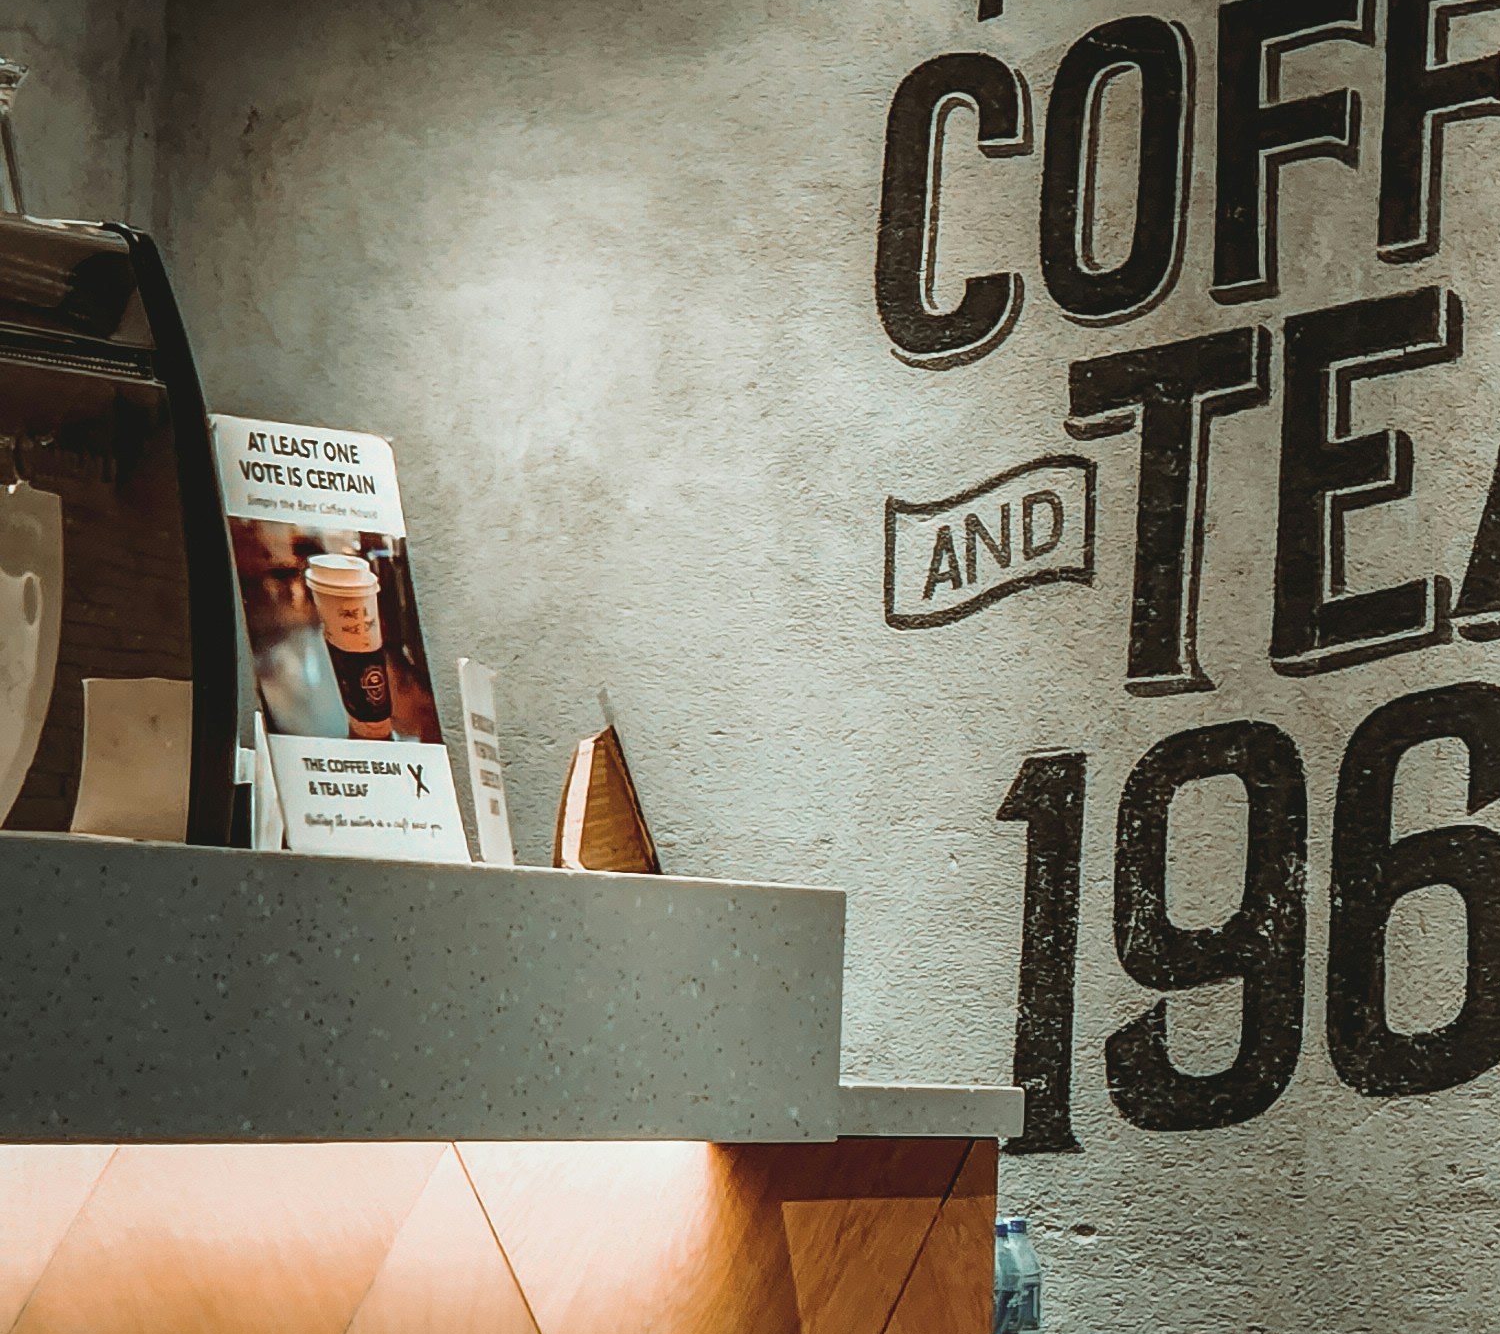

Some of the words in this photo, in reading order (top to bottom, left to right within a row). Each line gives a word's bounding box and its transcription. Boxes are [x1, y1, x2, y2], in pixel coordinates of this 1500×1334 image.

[247, 431, 267, 453] AT
[270, 434, 318, 459] LEAST
[323, 441, 360, 464] ONE
[238, 459, 285, 485] VOTE
[287, 466, 303, 487] IS
[306, 468, 376, 495] CERTAIN
[923, 488, 1064, 600] AND
[302, 757, 326, 772] THE
[327, 759, 370, 774] COFFEE
[371, 761, 402, 776] BEAN
[309, 781, 318, 796] &
[318, 781, 342, 796] TEA
[342, 782, 369, 797] LEAF
